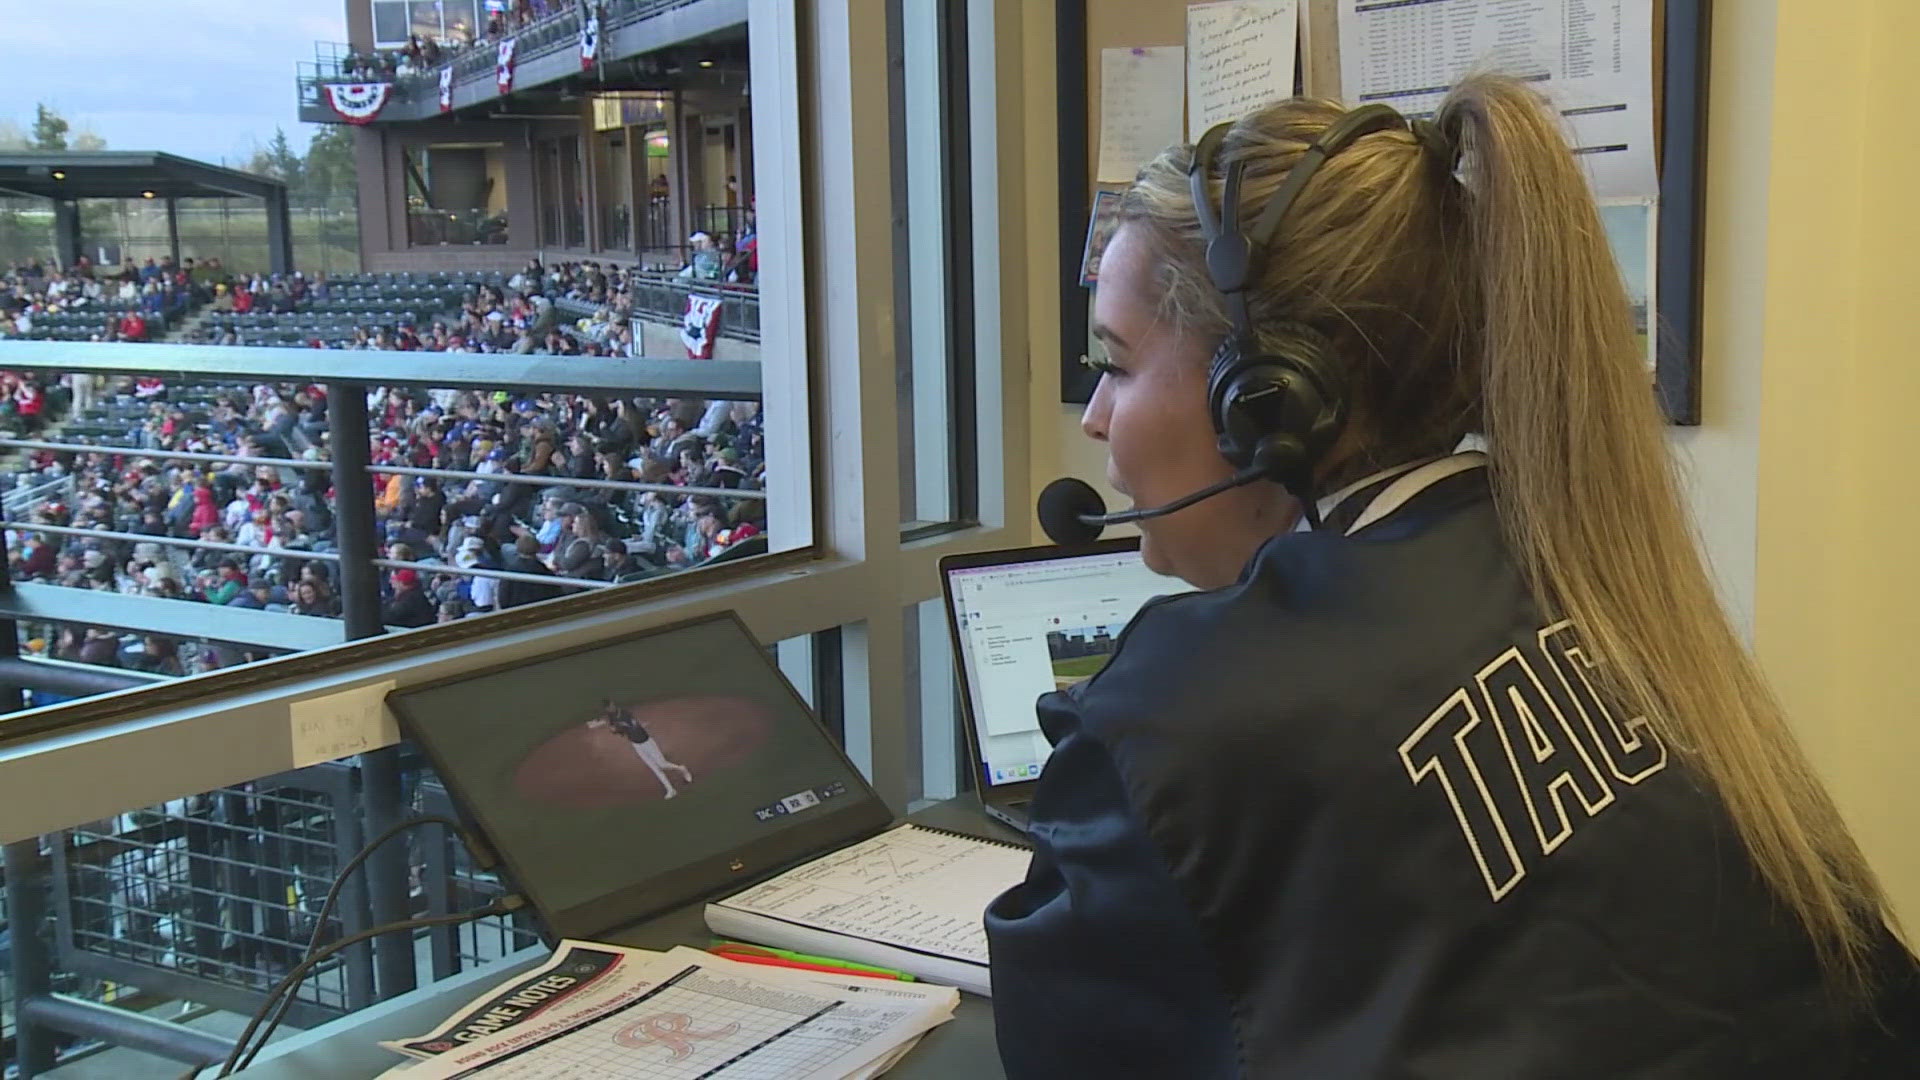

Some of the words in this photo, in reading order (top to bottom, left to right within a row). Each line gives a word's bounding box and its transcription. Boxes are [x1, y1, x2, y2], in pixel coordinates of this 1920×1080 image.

[1397, 618, 1668, 903] TAC
[755, 808, 774, 821] TAC
[775, 803, 785, 814] 0
[453, 1006, 522, 1043] GAME
[503, 974, 577, 1009] NOTES
